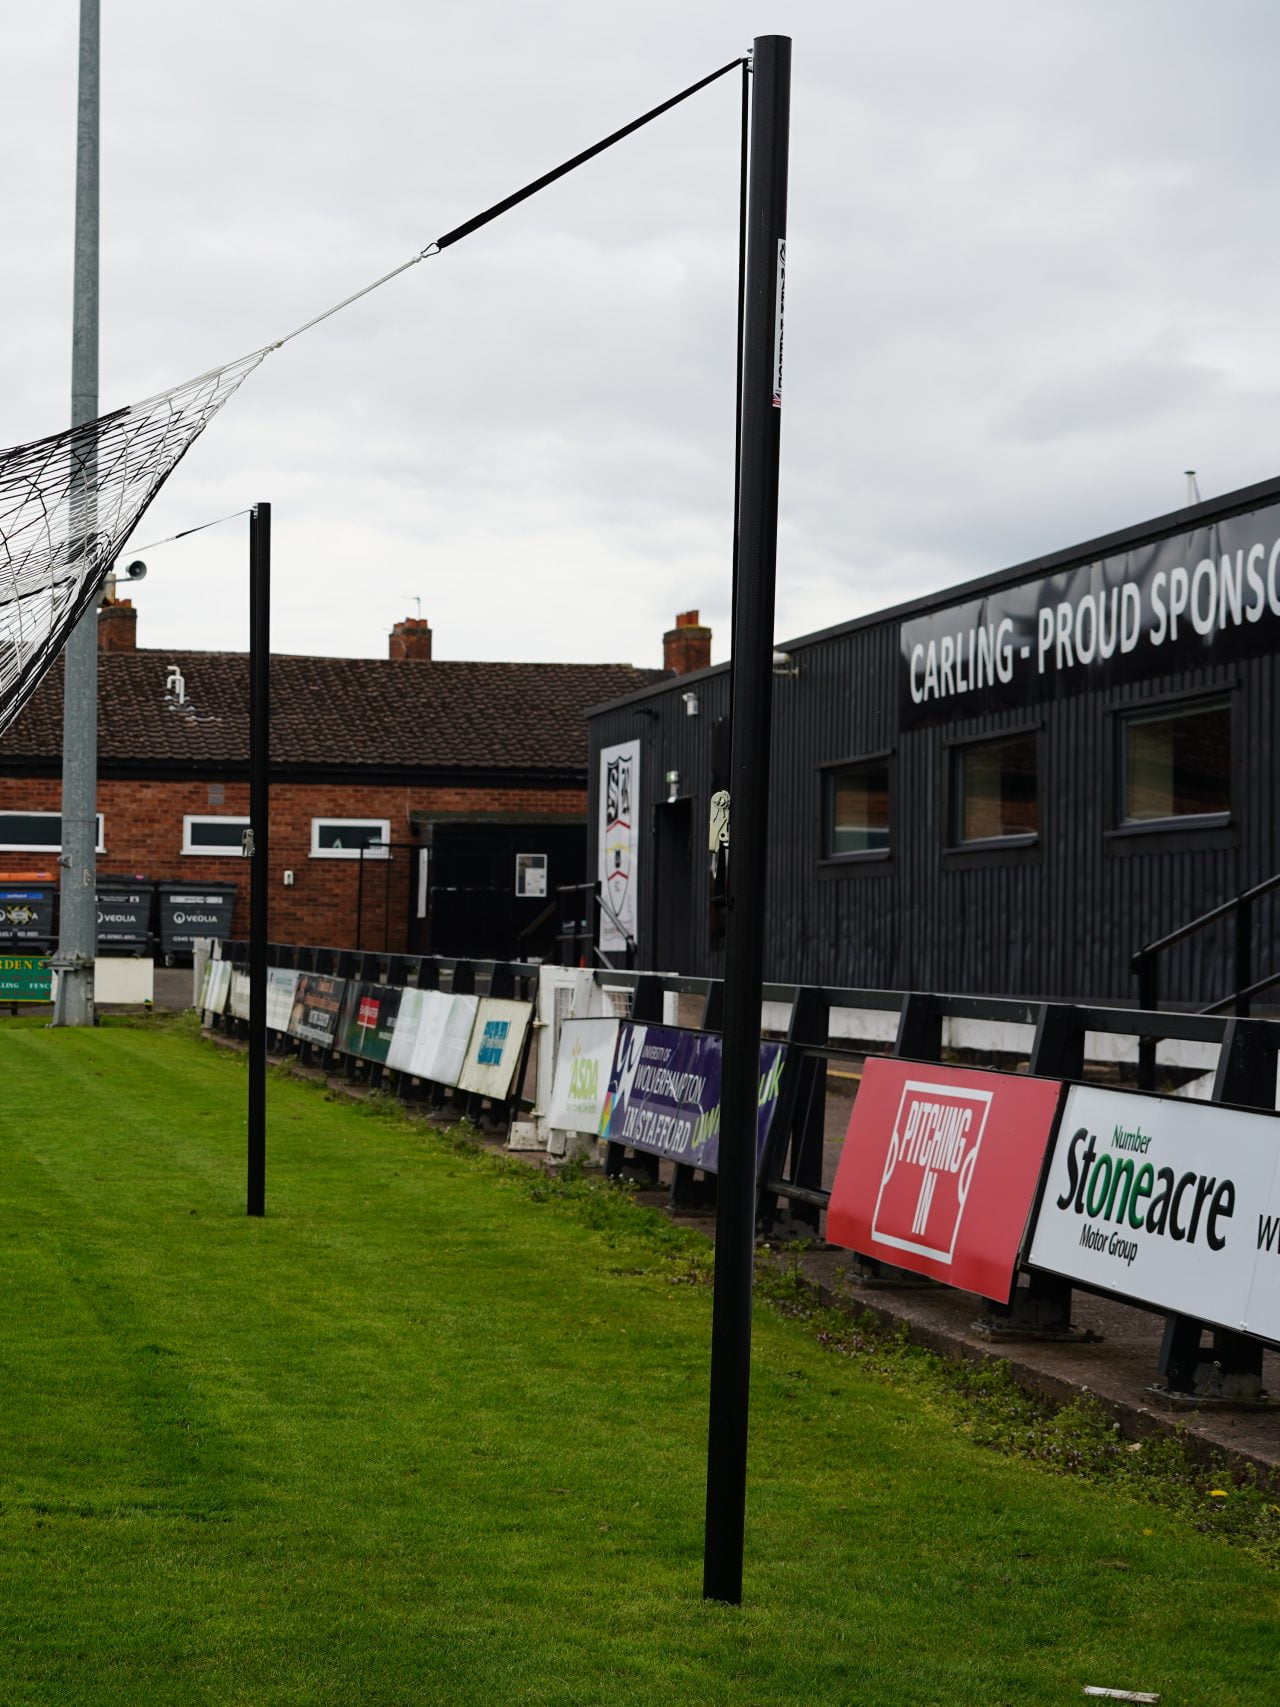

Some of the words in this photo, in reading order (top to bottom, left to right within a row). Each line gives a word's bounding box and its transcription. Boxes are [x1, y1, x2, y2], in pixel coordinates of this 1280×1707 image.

[909, 617, 1014, 704] CARLING
[1037, 581, 1142, 674] PROUD
[568, 1057, 599, 1101] ASDA
[634, 1064, 706, 1105] WOLVERHAMPTON
[622, 1106, 639, 1138] IN
[637, 1110, 691, 1154] STAFFORD
[898, 1100, 973, 1174] PITCHING
[1111, 1124, 1152, 1154] Number
[911, 1171, 938, 1236] IN
[1056, 1127, 1236, 1252] Stoneacre
[1079, 1223, 1108, 1253] Motor
[1108, 1231, 1138, 1267] Group
